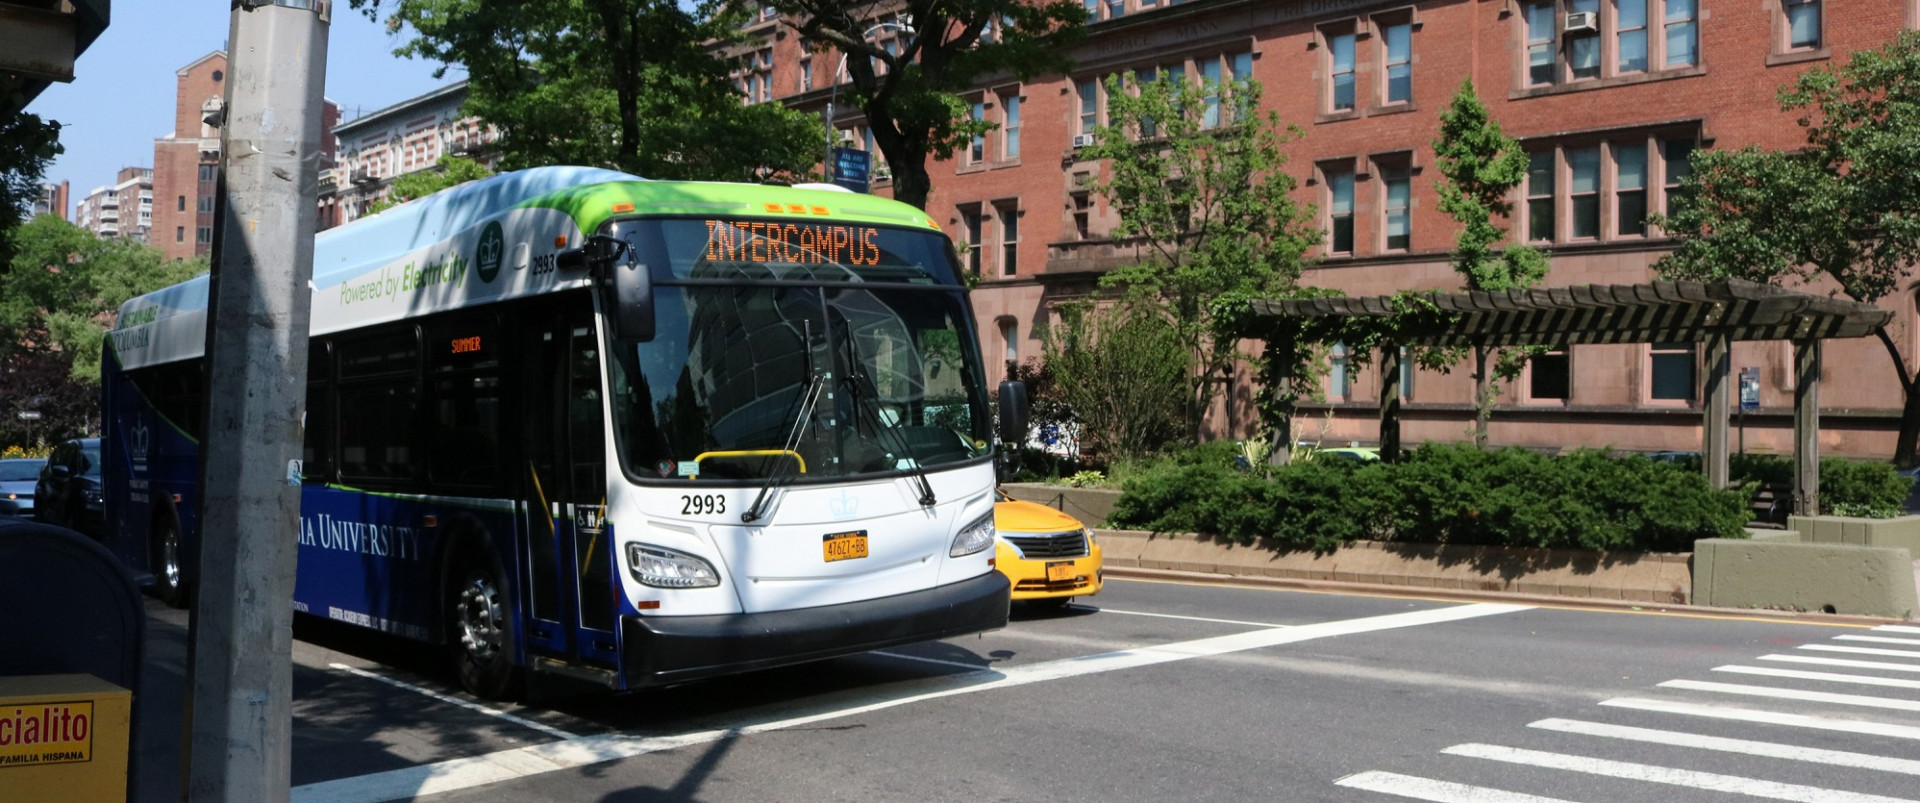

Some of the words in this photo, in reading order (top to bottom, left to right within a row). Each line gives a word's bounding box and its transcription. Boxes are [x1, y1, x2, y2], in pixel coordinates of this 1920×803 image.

[1176, 21, 1221, 40] MANN
[838, 160, 865, 170] WELCOME
[705, 220, 880, 266] INTERCAMPUS
[533, 254, 555, 276] 2993
[340, 268, 384, 305] Powered
[385, 272, 401, 303] by
[402, 250, 470, 292] Electricity
[451, 336, 481, 354] SUMMER
[681, 494, 726, 515] 2993
[298, 516, 316, 546] IA
[318, 512, 420, 561] UNIVERSITY
[0, 707, 88, 746] cialito
[0, 754, 39, 764] FAMILIA
[43, 751, 84, 761] HISPANA
